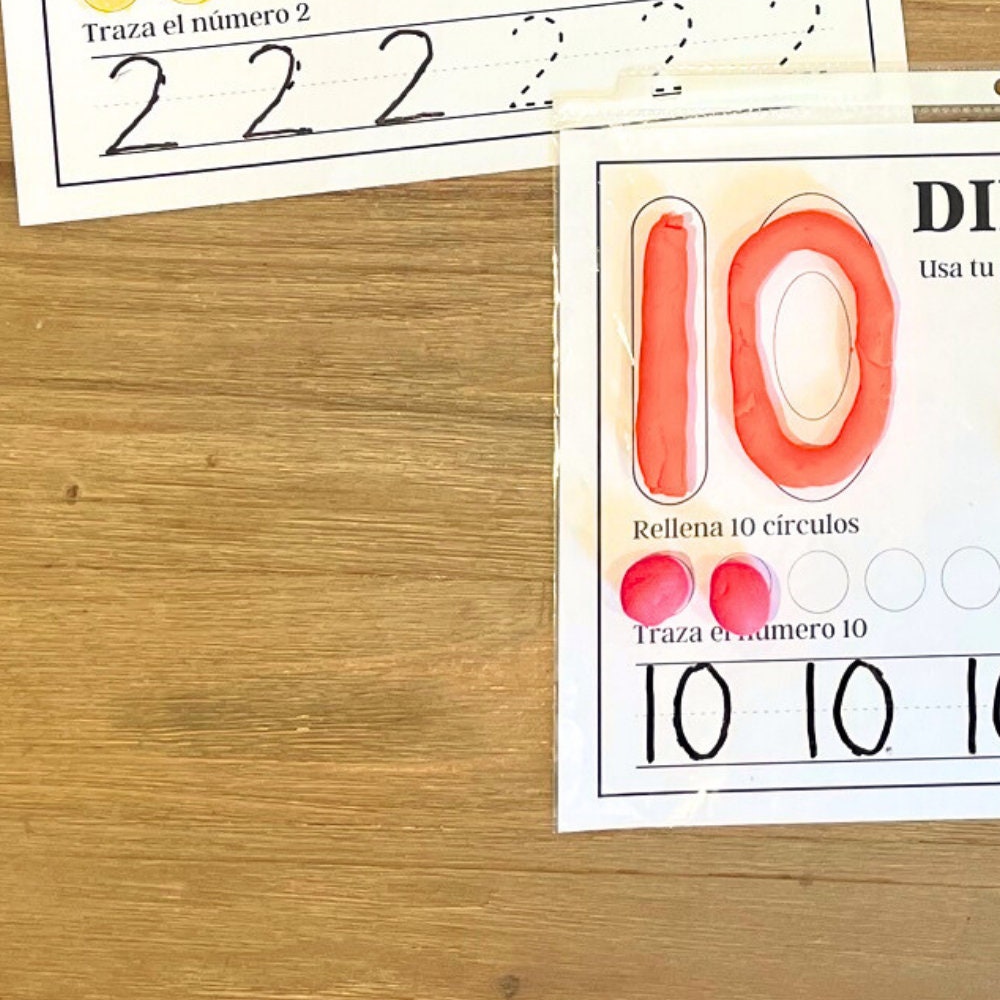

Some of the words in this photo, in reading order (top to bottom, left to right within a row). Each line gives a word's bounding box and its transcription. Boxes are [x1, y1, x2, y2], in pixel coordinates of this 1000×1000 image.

[82, 22, 156, 43] Traza
[163, 14, 184, 35] el
[192, 6, 290, 33] número
[296, 2, 311, 22] 2
[106, 55, 179, 155] 2
[243, 43, 313, 140] 2
[375, 29, 445, 126] 2
[509, 15, 564, 108] 2
[918, 260, 963, 279] Usa
[970, 259, 994, 278] tu
[631, 193, 895, 505] 10
[633, 517, 724, 540] Rellena
[731, 516, 756, 537] 10
[762, 513, 860, 536] círculos
[633, 622, 703, 645] Traza
[844, 618, 868, 638] 10
[646, 662, 732, 763] 10
[807, 659, 894, 759] 10
